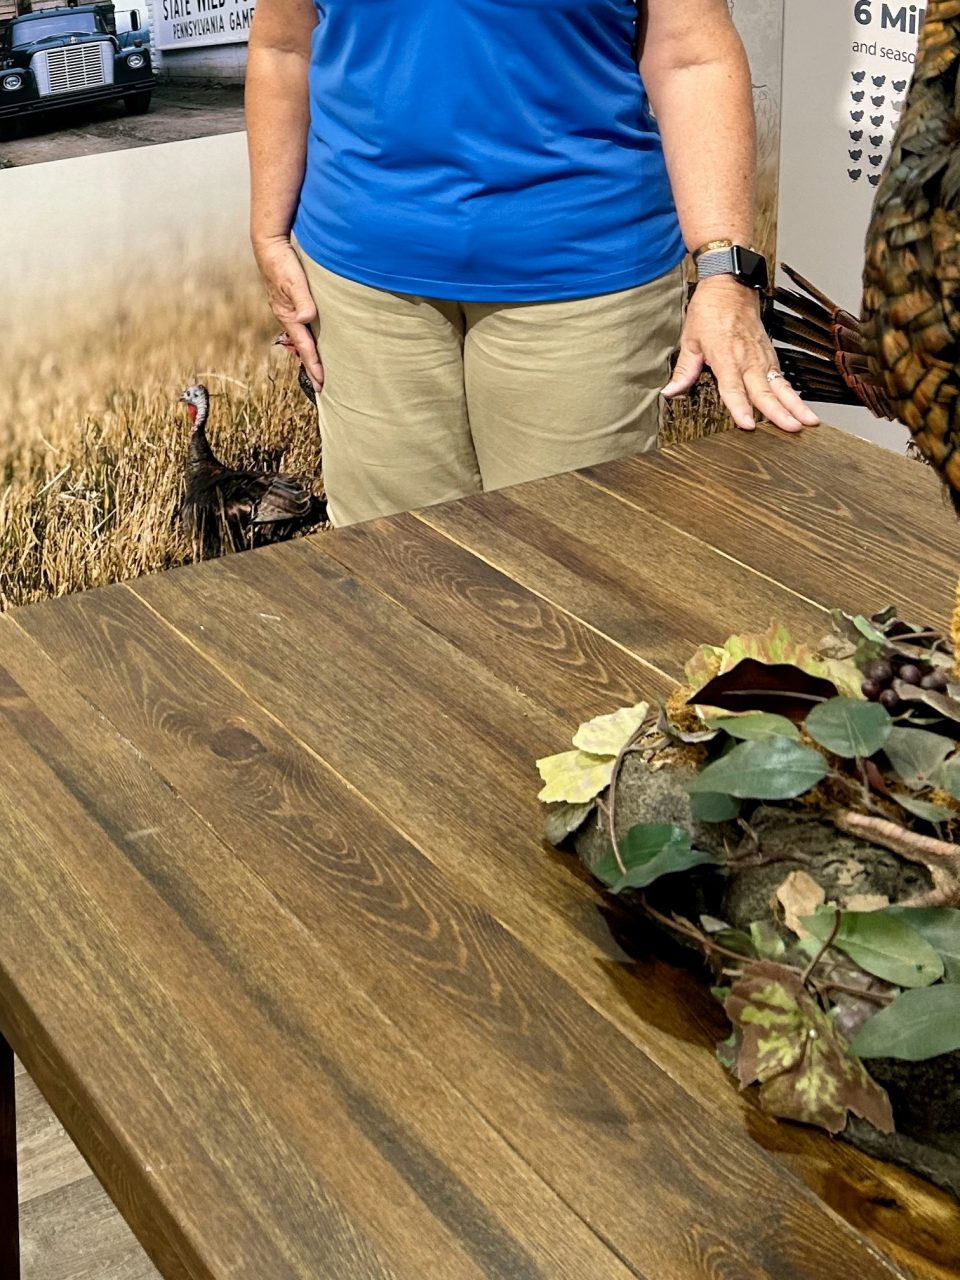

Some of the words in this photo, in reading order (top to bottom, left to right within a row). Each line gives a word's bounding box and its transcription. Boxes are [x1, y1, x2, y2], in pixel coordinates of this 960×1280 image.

[853, 0, 872, 25] 6
[173, 14, 225, 39] PENNSYLVANIA
[852, 41, 877, 56] and
[879, 46, 916, 64] seaso
